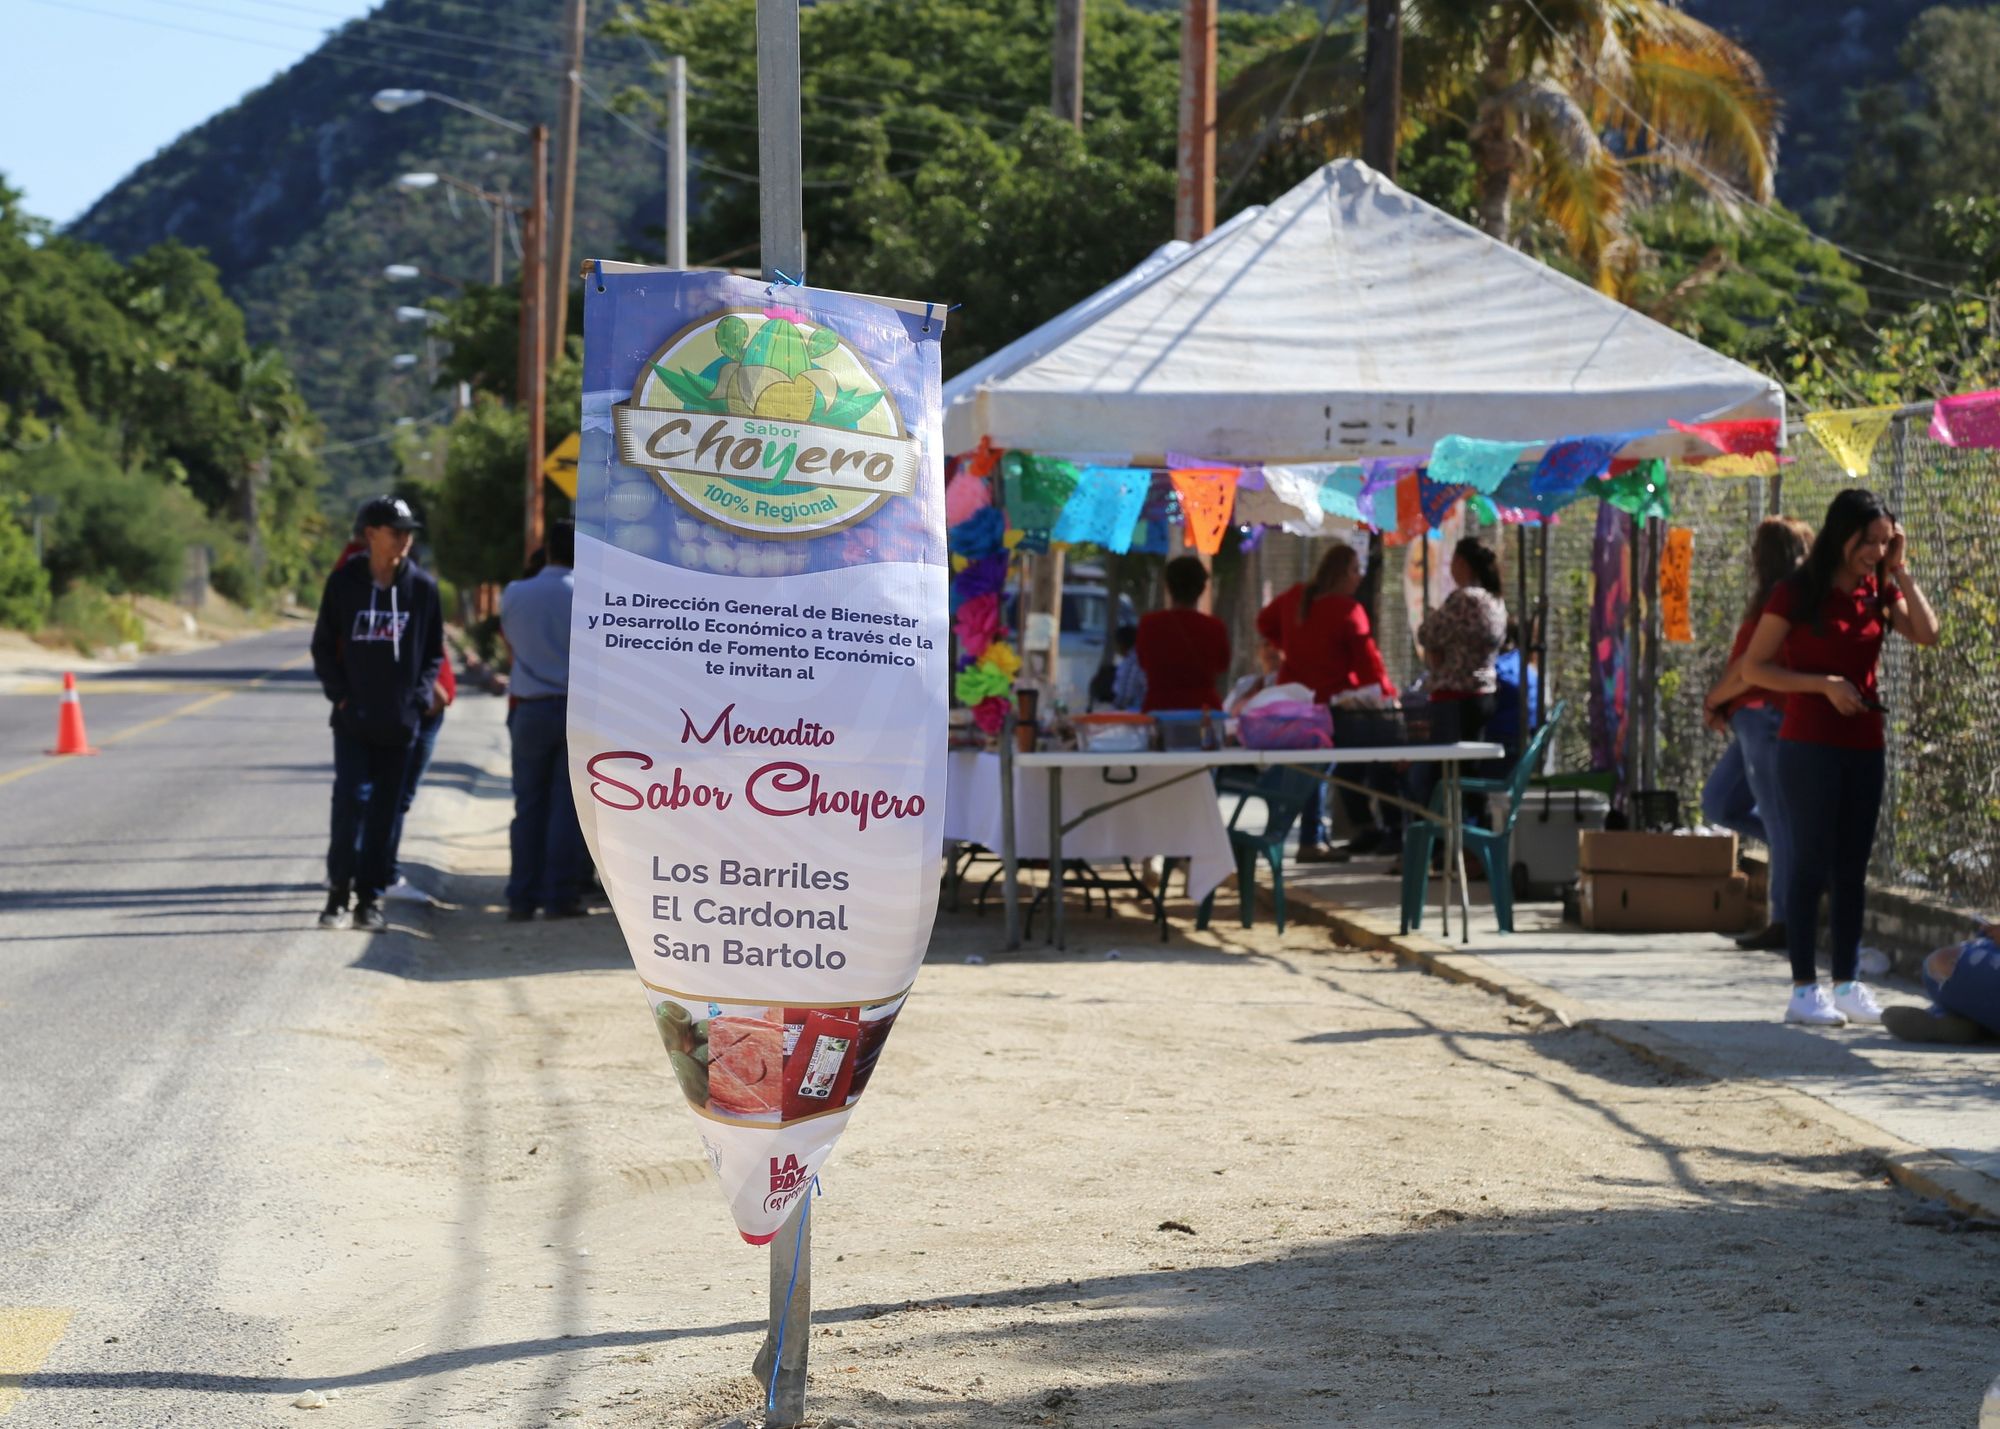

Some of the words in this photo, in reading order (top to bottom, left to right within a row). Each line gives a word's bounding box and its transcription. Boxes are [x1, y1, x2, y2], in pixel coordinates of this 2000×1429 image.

[743, 421, 801, 438] Sabor
[645, 419, 894, 489] Choyero
[703, 483, 750, 513] 100%
[755, 495, 838, 523] Regional
[605, 592, 627, 608] La
[632, 593, 720, 613] Dirección
[724, 599, 798, 618] General
[802, 604, 826, 620] de
[831, 607, 919, 629] Bienestar
[588, 615, 599, 630] y
[602, 613, 700, 632] Desarrollo
[705, 618, 807, 639] Económico
[811, 627, 823, 640] a
[827, 627, 884, 645] través
[888, 631, 912, 648] de
[917, 634, 934, 650] la
[605, 633, 694, 653] Dirección
[698, 639, 722, 654] de
[727, 641, 809, 659] Fomento
[814, 646, 916, 667] Económico
[705, 660, 725, 676] te
[729, 662, 792, 679] invitan
[796, 665, 815, 680] al
[679, 702, 835, 748] Mercadito
[586, 750, 733, 811] Sabor
[745, 761, 925, 832] Choyero
[653, 855, 709, 884] Los
[720, 859, 850, 891] Barriles
[653, 895, 682, 922] El
[694, 898, 849, 931] Cardonal
[653, 933, 710, 963] San
[722, 939, 846, 970] Bartolo
[770, 1153, 799, 1176] LA
[770, 1164, 808, 1192] PAZ
